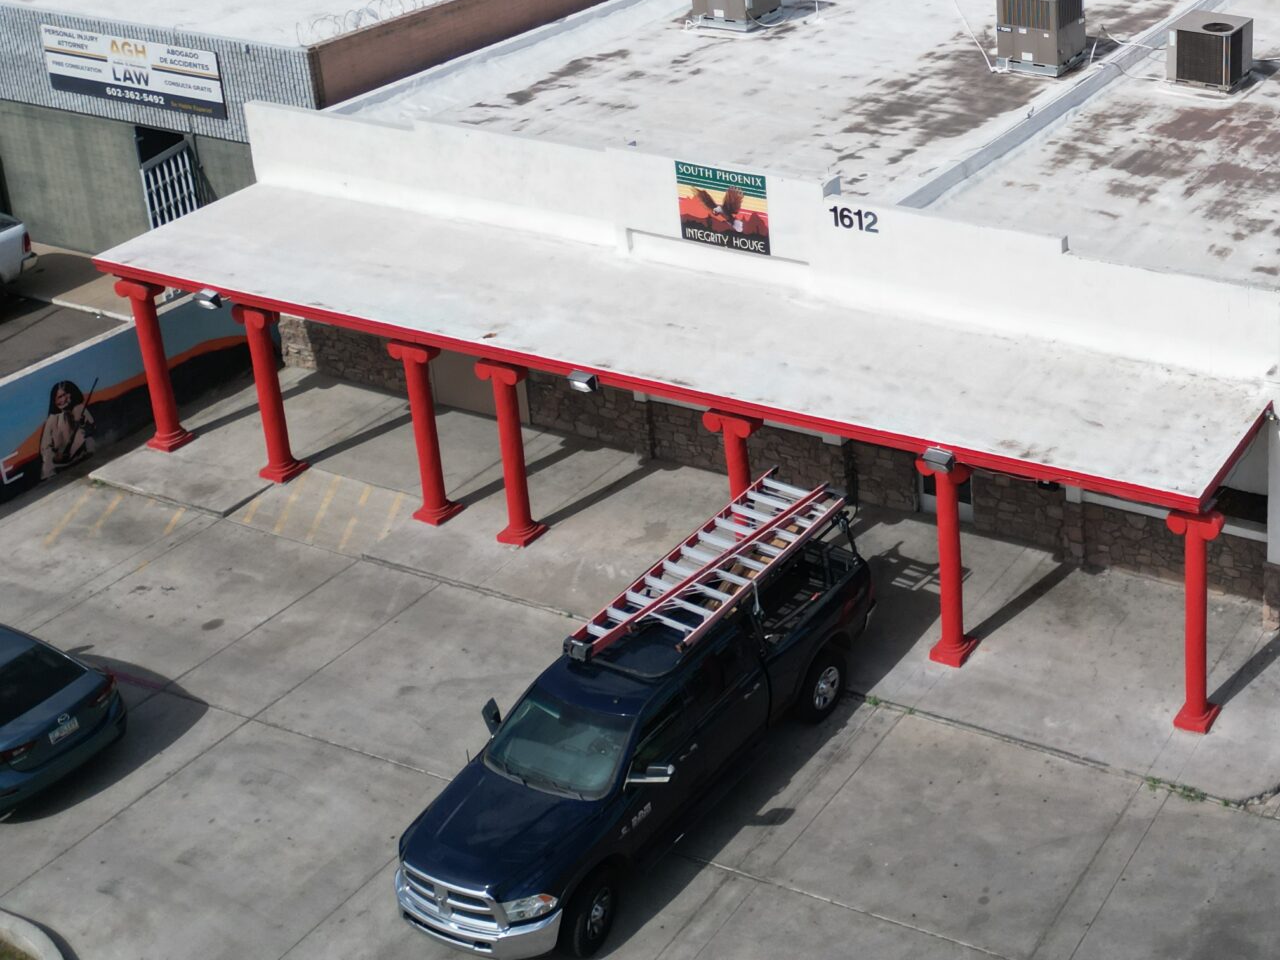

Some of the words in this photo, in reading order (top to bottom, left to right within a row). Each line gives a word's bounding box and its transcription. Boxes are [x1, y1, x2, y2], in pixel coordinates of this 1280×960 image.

[43, 28, 75, 39] PERSONAL
[76, 33, 98, 42] INJURY
[57, 39, 89, 50] ATTORNEY
[111, 39, 147, 59] AGH
[166, 48, 199, 60] ABOGADO
[160, 56, 168, 65] DE
[169, 59, 210, 71] ACCIDENTES
[112, 66, 149, 87] LAW
[105, 86, 165, 105] 602-362-5492
[678, 164, 713, 179] SOUTH
[716, 170, 763, 187] PHOENIX
[829, 206, 879, 233] 1612
[685, 227, 730, 245] INTEGRITY
[732, 234, 766, 253] HOUSE
